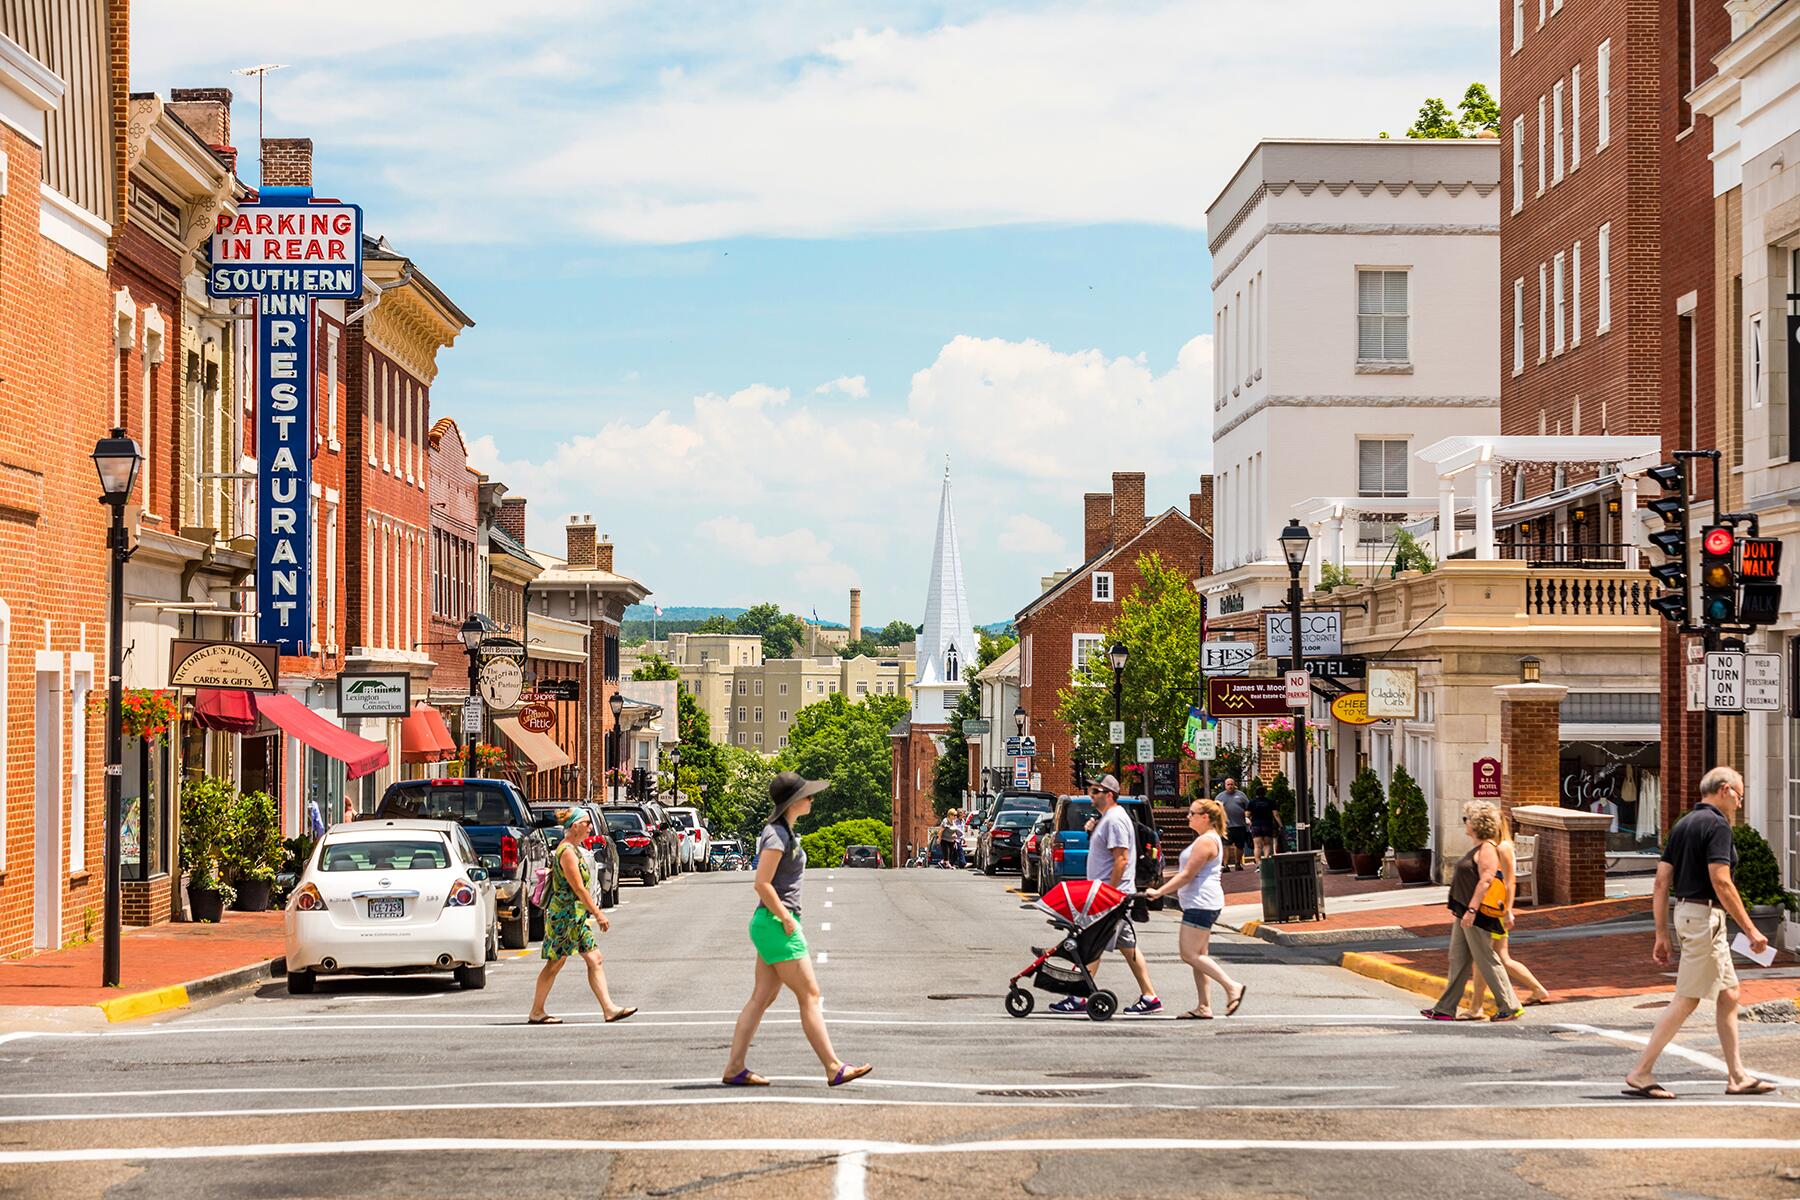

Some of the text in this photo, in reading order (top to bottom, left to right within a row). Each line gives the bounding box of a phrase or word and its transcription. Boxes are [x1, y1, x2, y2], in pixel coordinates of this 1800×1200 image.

[216, 214, 352, 235] PARKING
[222, 239, 347, 260] IN REAR
[215, 269, 352, 291] SOUTHERN
[262, 294, 306, 315] INN
[270, 320, 299, 627] RESTAURANT
[1743, 560, 1774, 576] WALK
[1270, 616, 1337, 634] ROCCA
[1271, 633, 1337, 643] BAR STORANTE
[1206, 648, 1253, 666] HESS
[1718, 656, 1733, 667] NO
[228, 647, 271, 688] HALLMARK
[1304, 661, 1348, 675] OTEL
[1711, 669, 1739, 680] TURN
[193, 676, 253, 686] CARDS & GIFTS
[1291, 676, 1304, 686] NO
[1717, 682, 1733, 693] ON
[345, 694, 379, 702] Lexington
[1714, 695, 1735, 707] RED
[1746, 697, 1778, 705] CROSSWALK
[362, 703, 402, 711] Connection
[1337, 699, 1367, 709] CHEE
[524, 707, 537, 715] The
[530, 718, 551, 728] Attic
